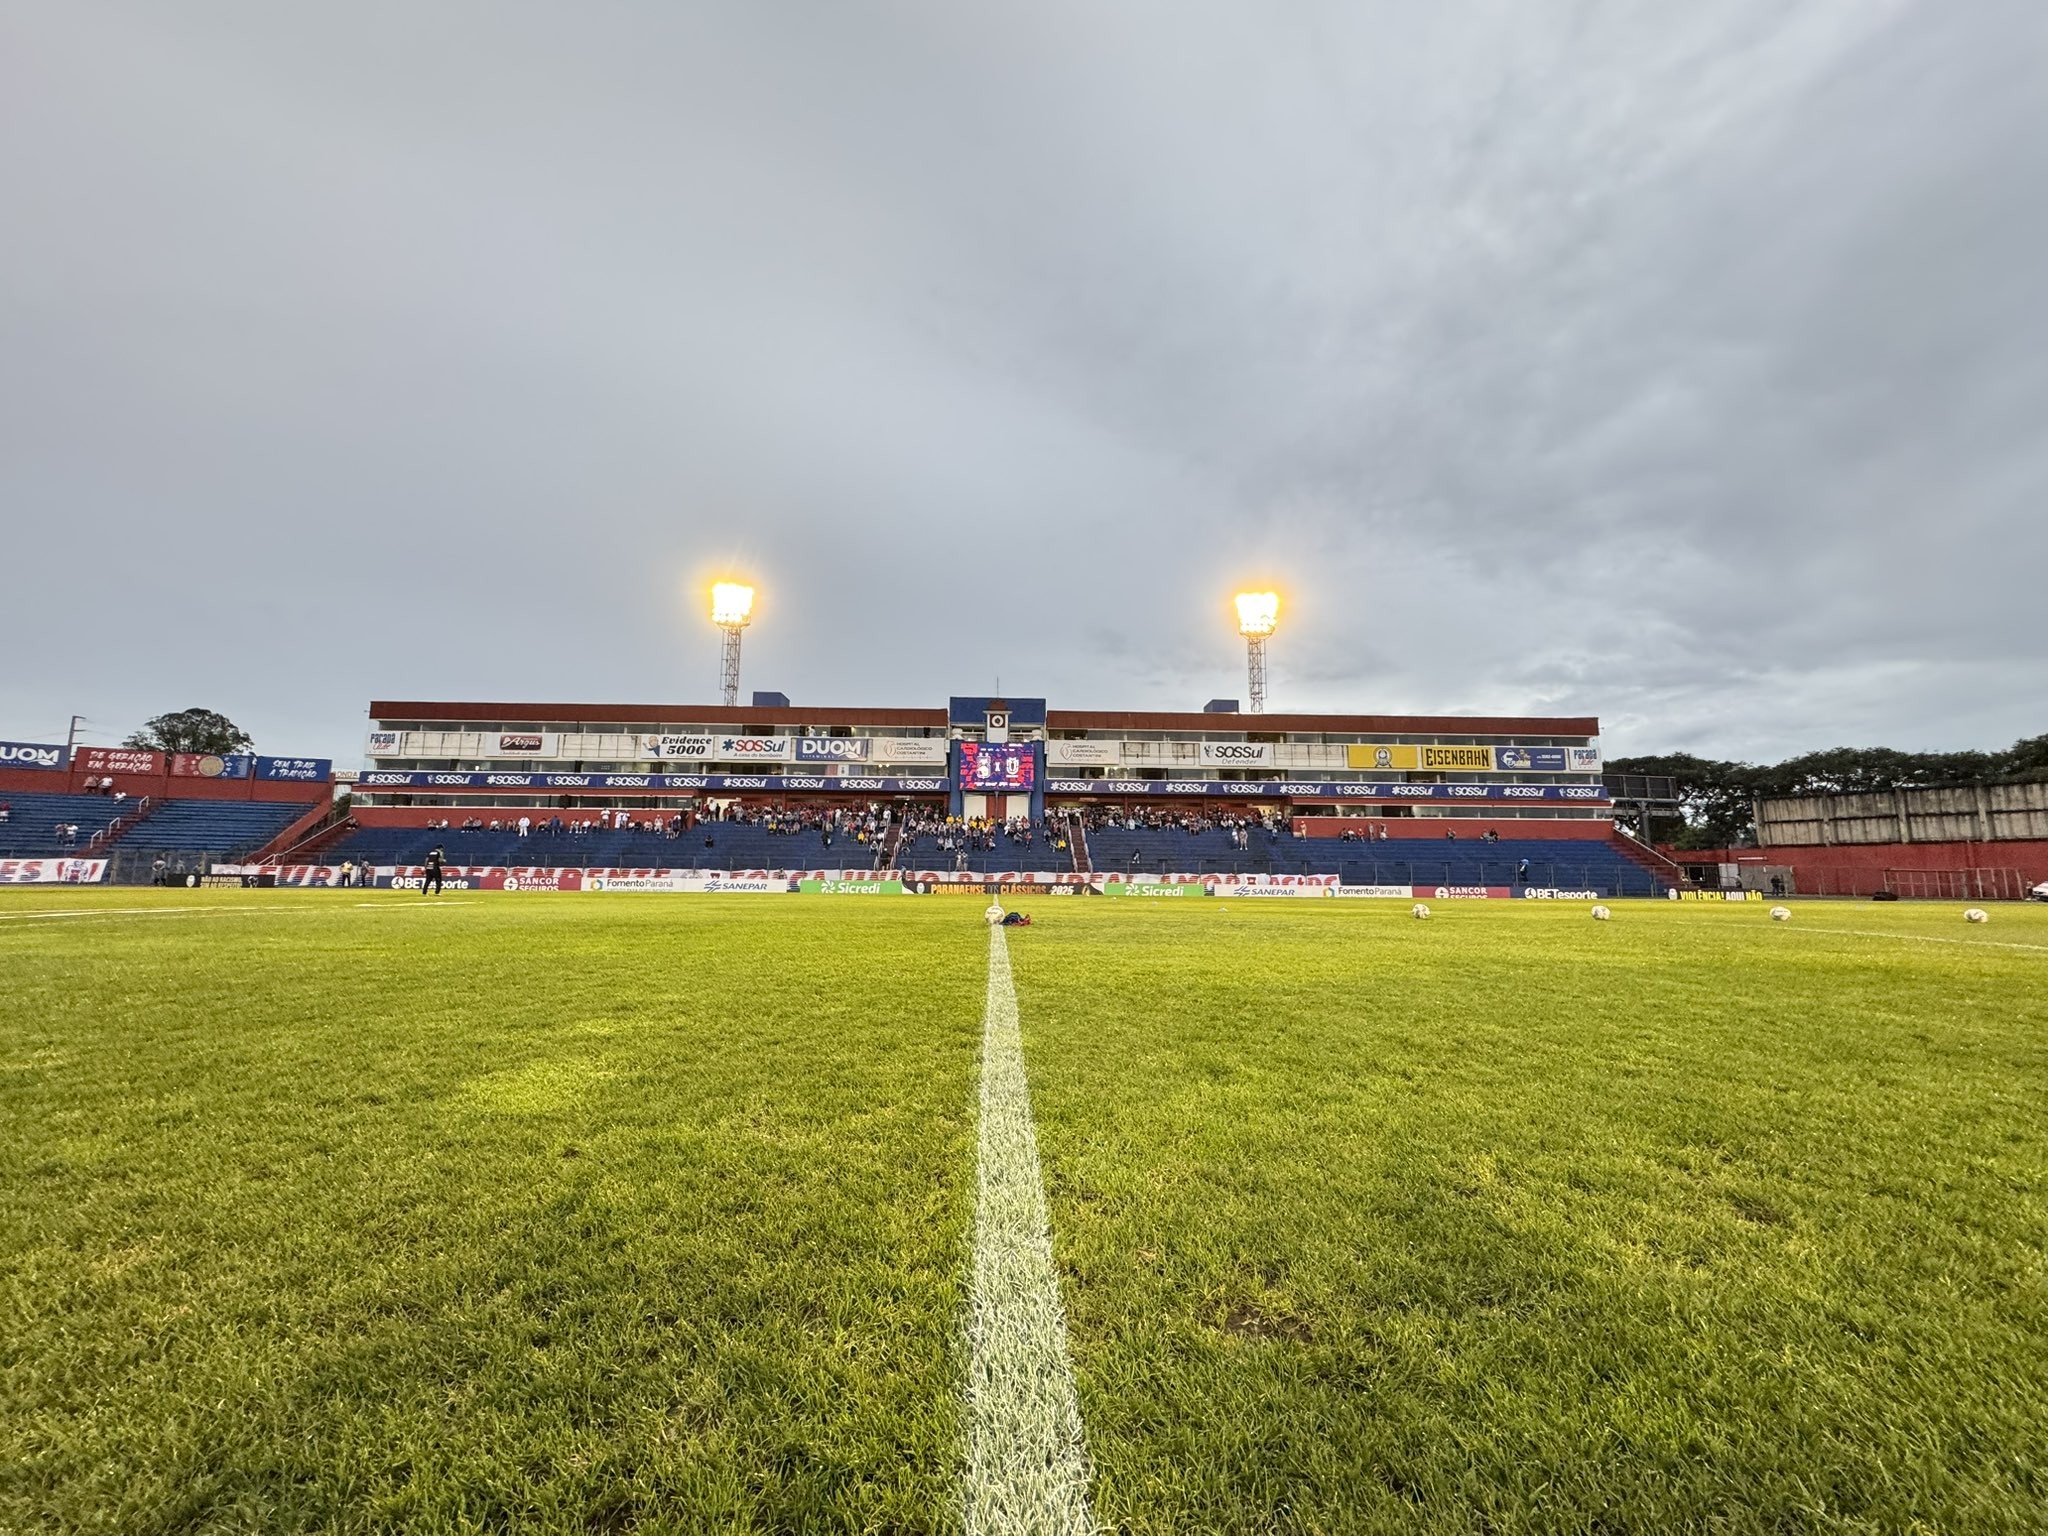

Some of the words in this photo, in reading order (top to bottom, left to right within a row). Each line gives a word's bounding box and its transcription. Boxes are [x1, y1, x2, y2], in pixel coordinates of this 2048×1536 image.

[504, 737, 541, 749] Argus
[661, 736, 712, 745] Evidence
[734, 739, 786, 752] SOSSul
[666, 745, 706, 755] 5000
[802, 740, 861, 754] DUOM
[1215, 746, 1264, 758] SOSSul
[90, 751, 106, 759] DE
[1426, 748, 1489, 767] EISENBAHN
[88, 760, 102, 769] EM
[273, 760, 291, 768] SEM
[375, 775, 412, 784] SOSSul
[434, 775, 472, 784] SOSSul
[496, 775, 532, 785] SOSSul
[554, 776, 591, 785] SOSSul
[611, 776, 650, 786] SOSSul
[671, 777, 708, 787] SOSSul
[731, 777, 767, 787] SOSSul
[789, 778, 825, 788] SOSSul
[848, 779, 884, 789] SOSSul
[906, 780, 943, 790] SOSSul
[1060, 782, 1094, 791] SOSSul
[1115, 782, 1151, 792] SOSSul
[1174, 783, 1209, 793] SOSSul
[1229, 784, 1265, 793] SOSSul
[1287, 784, 1322, 794] SOSSul
[1343, 785, 1378, 795] SOSSul
[1400, 786, 1434, 795] SOSSul
[1454, 786, 1490, 796] SOSSul
[1511, 787, 1547, 797] SOSSul
[1566, 788, 1601, 798] SOSSul
[520, 877, 559, 885] SANCOR
[722, 882, 768, 890] SANEPAR
[837, 882, 880, 894] Sicredi
[930, 884, 986, 895] PARANAENSE
[1000, 882, 1047, 895] CLÁSSICOS
[1050, 885, 1075, 896] 2025
[1141, 886, 1185, 897] Sicredi
[1251, 888, 1295, 896] SANEPAR
[1449, 886, 1488, 895] SANCOR
[1536, 888, 1598, 900] BETesporte
[1680, 889, 1724, 900] VIOLÊNCIA!
[1725, 891, 1745, 900] AQUI
[1745, 889, 1763, 900] NÃO
